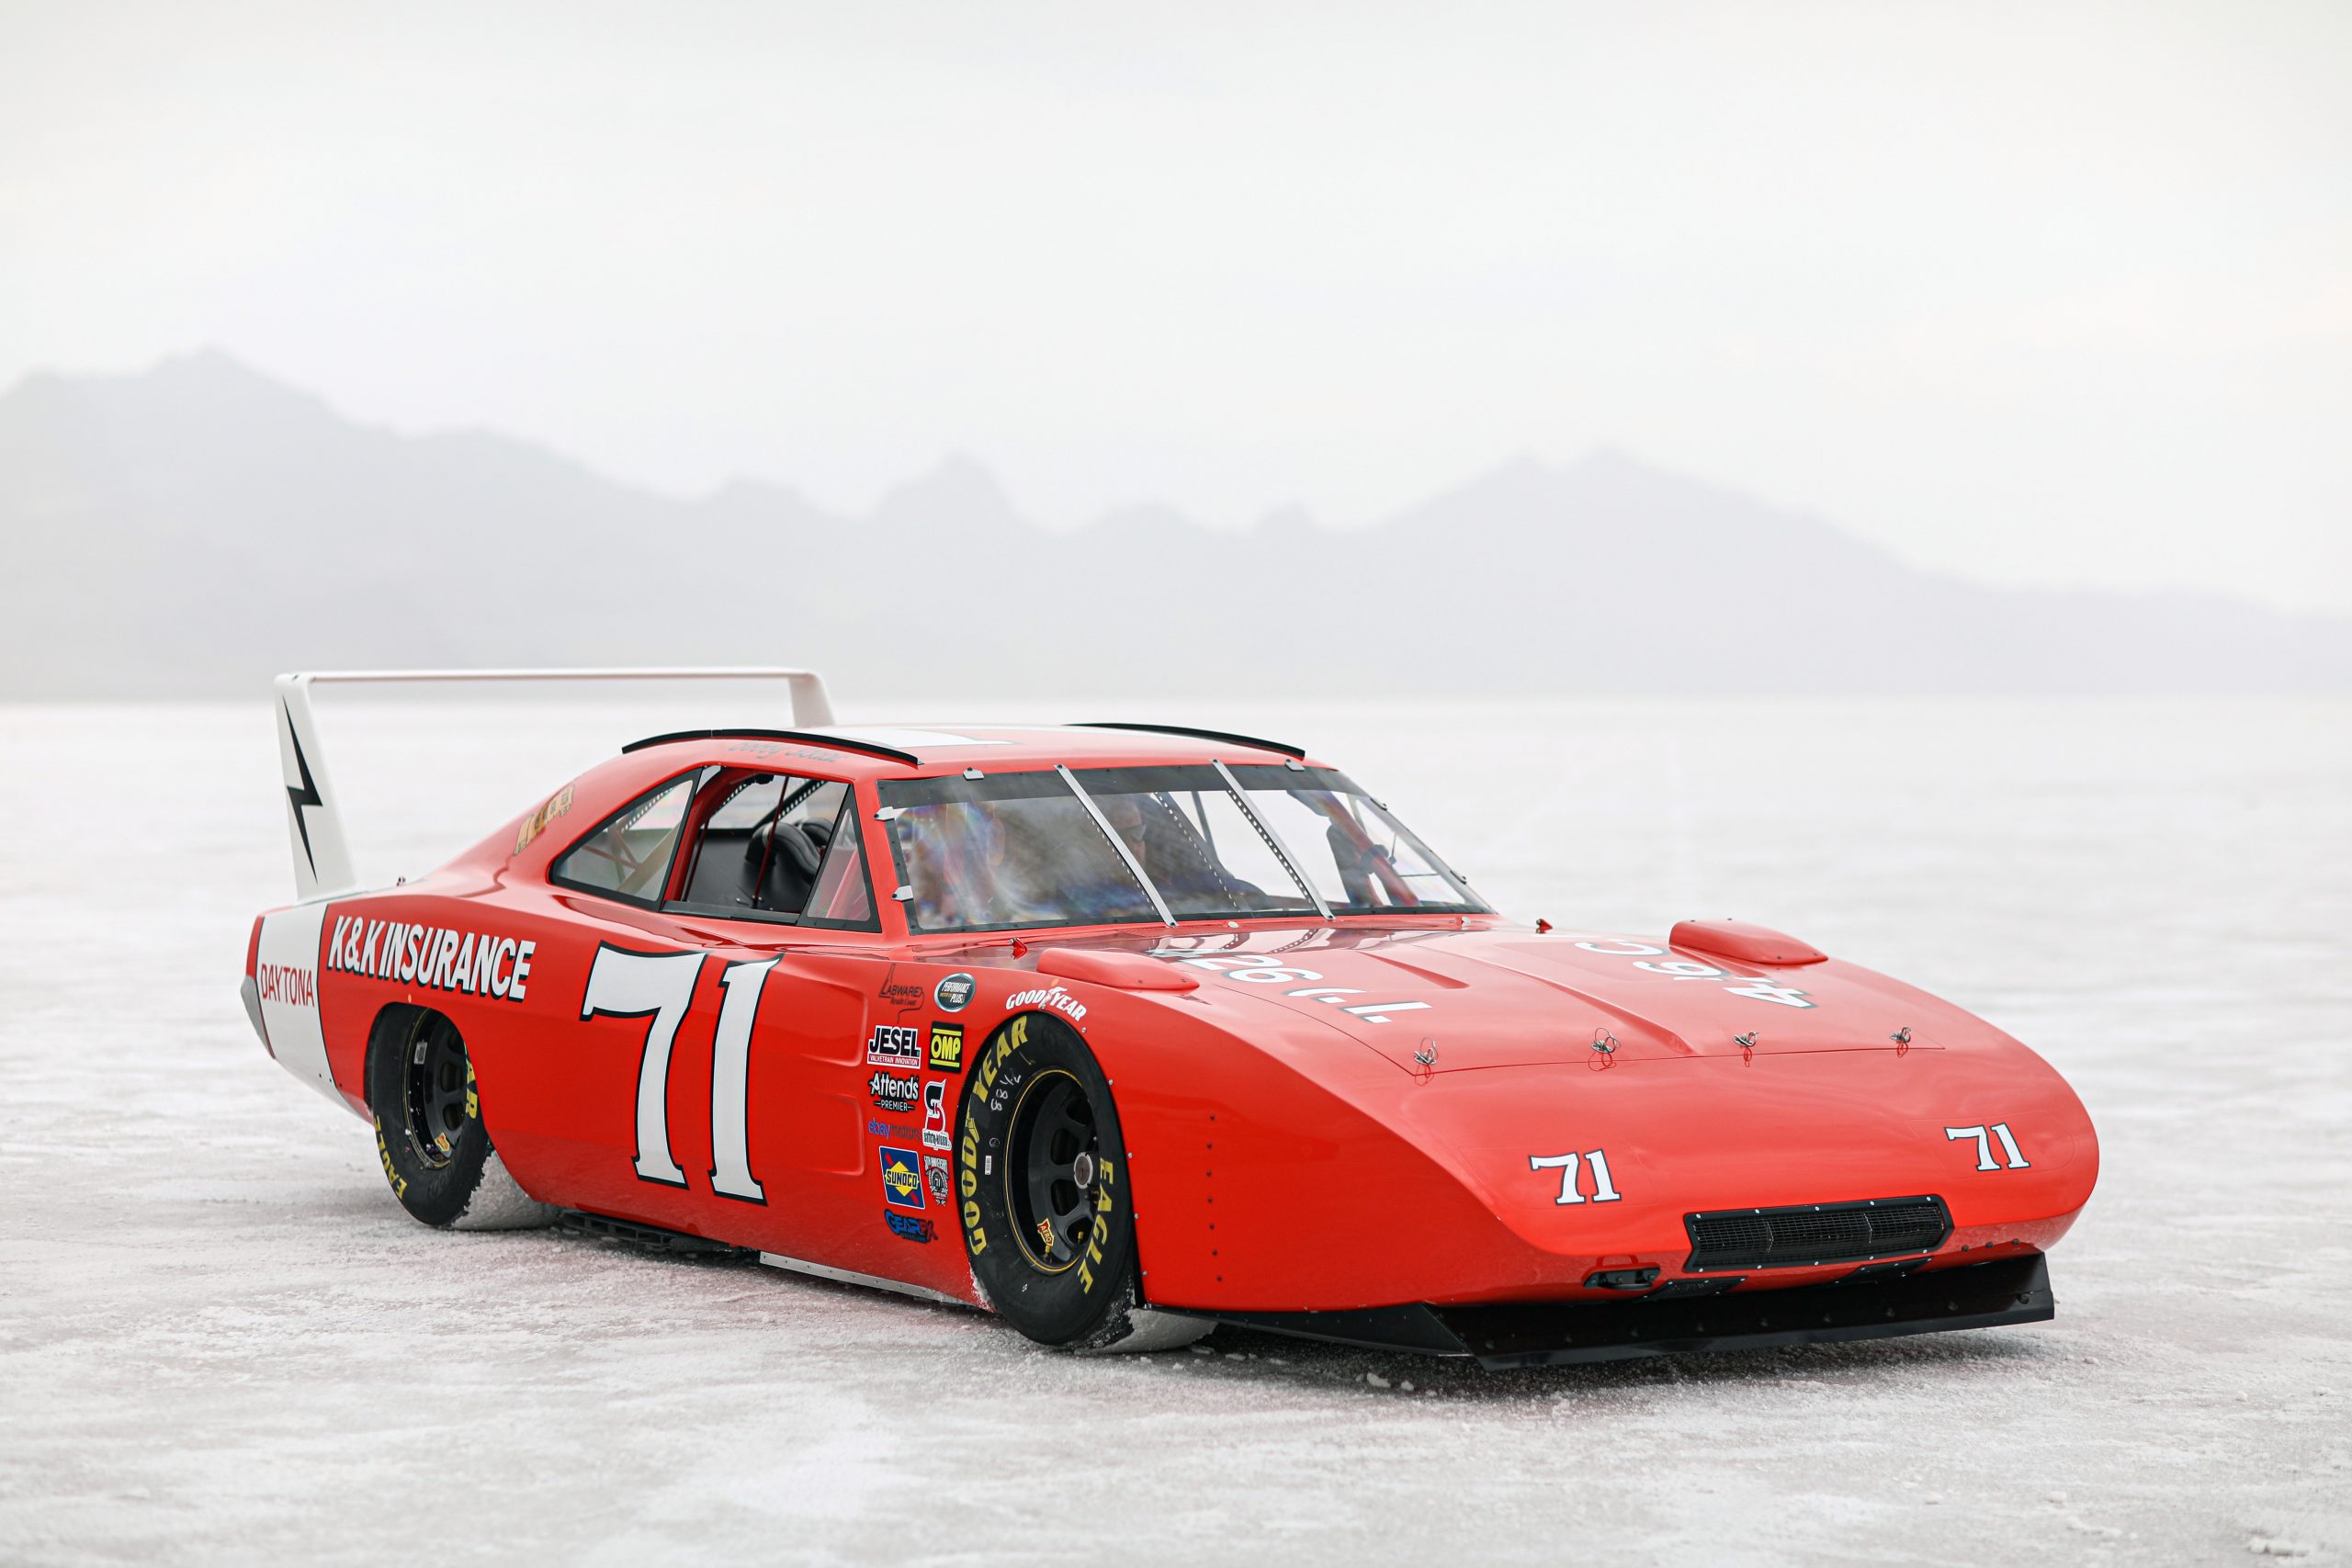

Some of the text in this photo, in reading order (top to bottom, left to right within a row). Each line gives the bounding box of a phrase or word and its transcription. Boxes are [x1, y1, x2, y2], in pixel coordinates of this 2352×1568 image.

[327, 915, 536, 1003] K&K INSURANCE
[260, 964, 315, 1008] DAYTONA
[942, 981, 971, 994] PERFORMANCE
[1005, 986, 1088, 1022] GOODYEAR
[869, 1026, 920, 1057] JESEL
[931, 1034, 962, 1061] OMP
[579, 939, 786, 1207] 71
[895, 1057, 919, 1066] INNOVATION
[869, 1072, 919, 1100] Attends
[881, 1100, 908, 1111] PREMIER
[374, 1114, 408, 1200] EAGLE
[1944, 1122, 2031, 1172] 71
[887, 1169, 918, 1188] SUNOCO
[1528, 1148, 1622, 1206] 71
[1040, 1225, 1052, 1243] AERO
[1077, 1156, 1114, 1296] EAGLE
